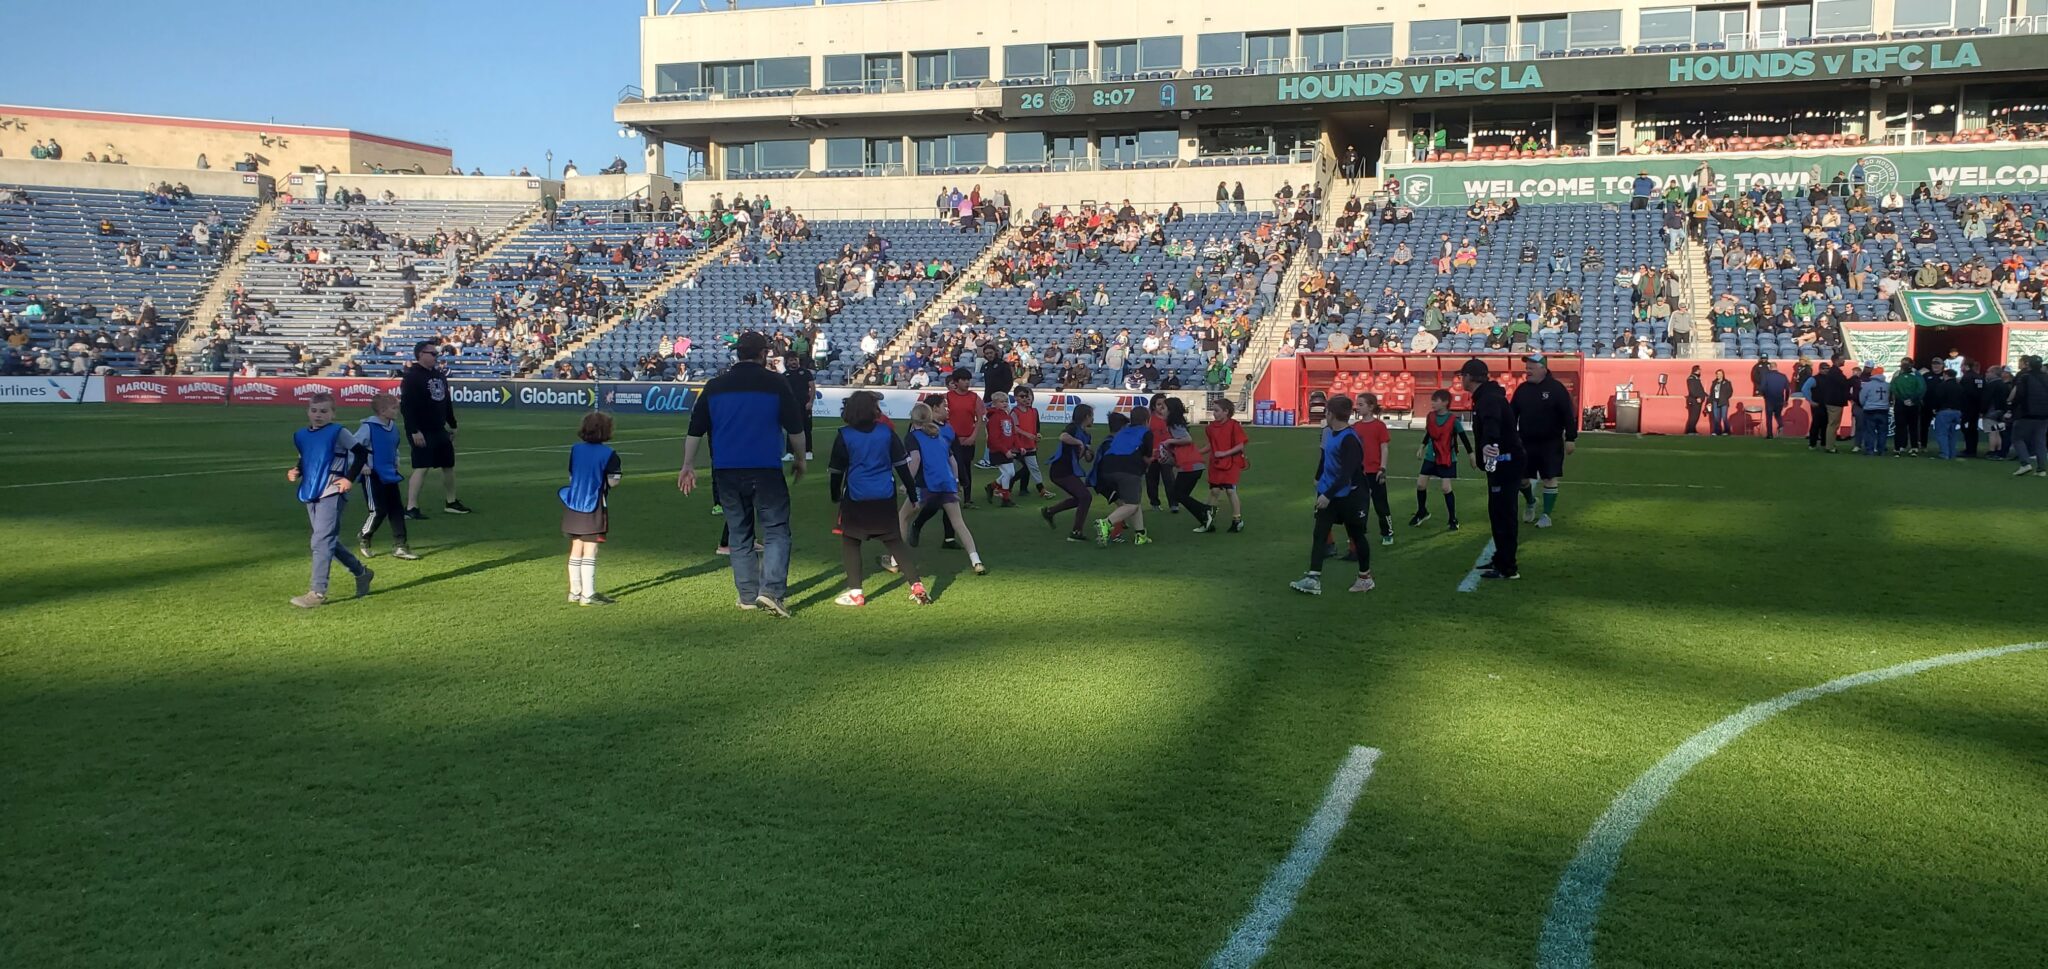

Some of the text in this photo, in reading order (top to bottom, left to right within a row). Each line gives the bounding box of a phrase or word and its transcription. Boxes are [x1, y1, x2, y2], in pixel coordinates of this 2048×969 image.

[1669, 42, 1982, 82] HOUNDS v RFC LA
[1278, 65, 1544, 100] HOUNDS v PFC LA
[1020, 93, 1044, 109] 26
[1093, 88, 1135, 106] 8:07
[1193, 84, 1213, 101] 12
[1463, 177, 1595, 199] WELCOME
[1600, 176, 1634, 195] TO
[0, 384, 46, 396] irlines
[116, 381, 168, 395] MARQUEE
[178, 382, 225, 396] MARQUEE
[233, 382, 279, 397] MARQUEE
[450, 386, 501, 403] lobant
[520, 387, 587, 406] Globant
[645, 385, 690, 411] Cold
